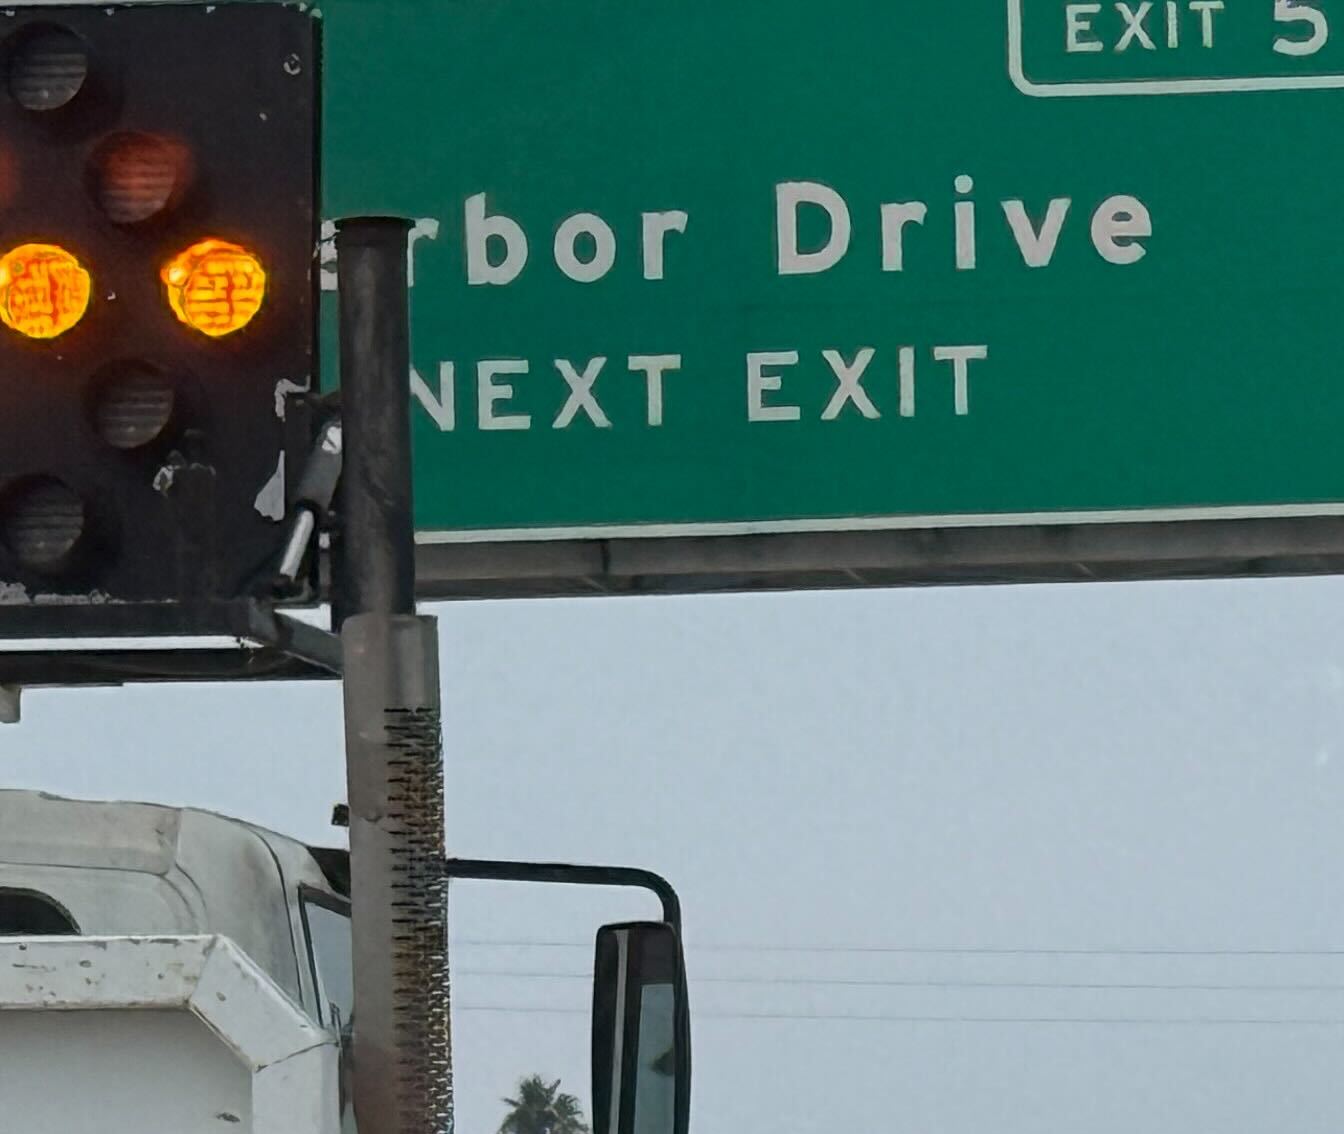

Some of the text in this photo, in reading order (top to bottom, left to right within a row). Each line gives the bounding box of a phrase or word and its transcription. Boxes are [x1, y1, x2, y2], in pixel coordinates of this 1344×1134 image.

[1065, 1, 1224, 54] EXIT
[775, 174, 1153, 276] Drive
[409, 344, 989, 431] NEXT EXIT
